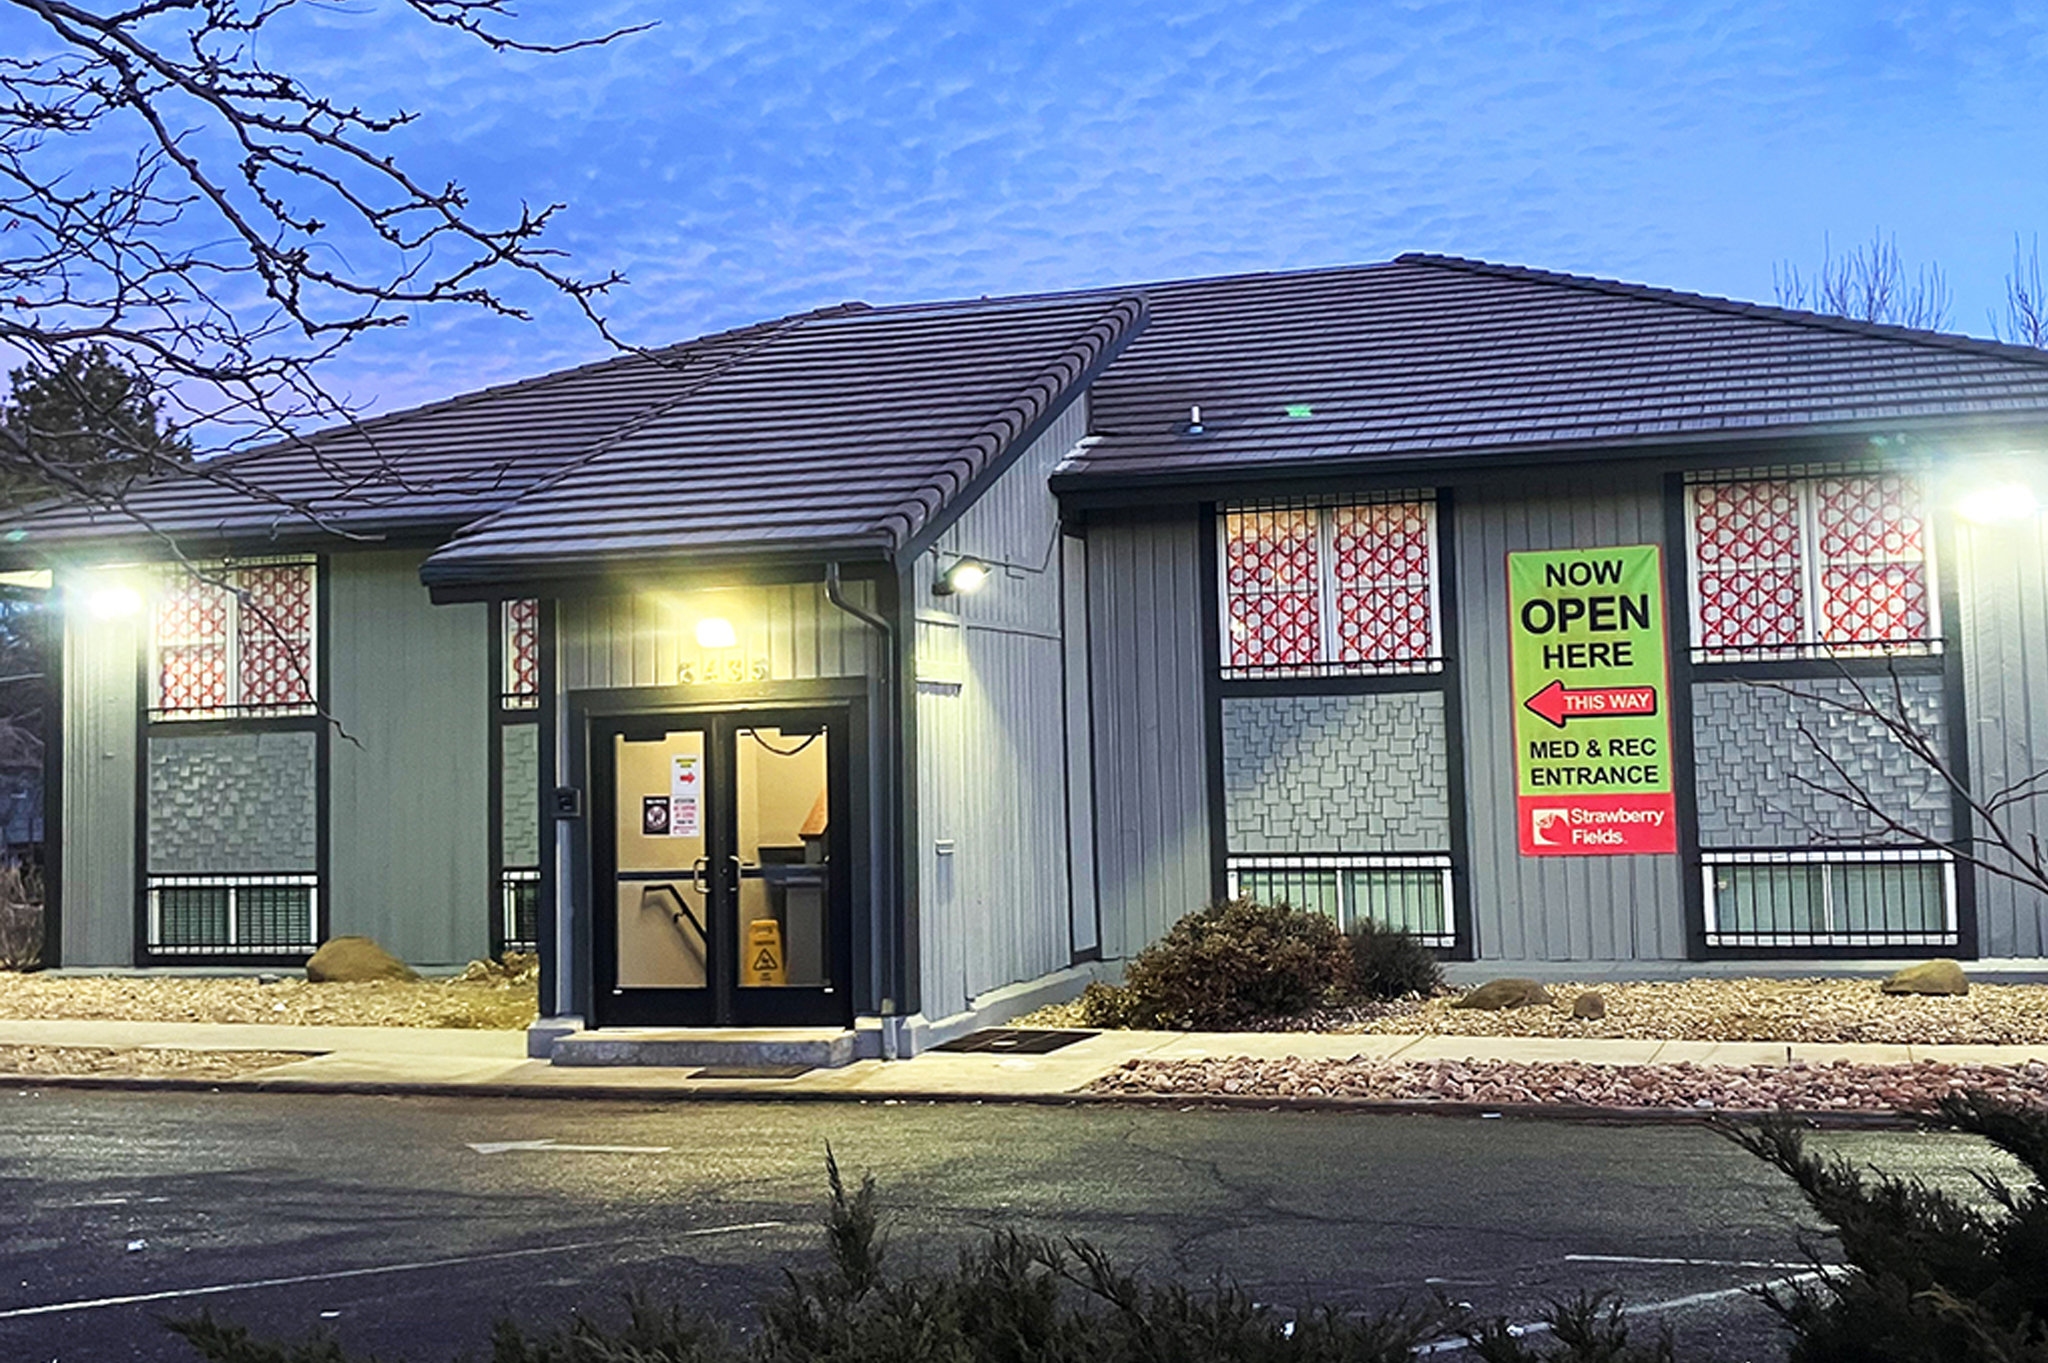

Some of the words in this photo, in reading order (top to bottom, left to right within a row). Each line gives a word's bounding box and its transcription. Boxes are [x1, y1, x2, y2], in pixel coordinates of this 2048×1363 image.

[1546, 560, 1623, 587] NOW
[1521, 594, 1650, 634] OPEN
[1543, 641, 1633, 669] HERE
[1564, 695, 1605, 710] THIS
[1609, 693, 1650, 708] WAY
[1530, 740, 1579, 758] MED
[1586, 739, 1602, 757] &
[1609, 738, 1657, 756] REC
[1531, 765, 1659, 786] ENTRANCE
[1571, 808, 1664, 826] Strawberry
